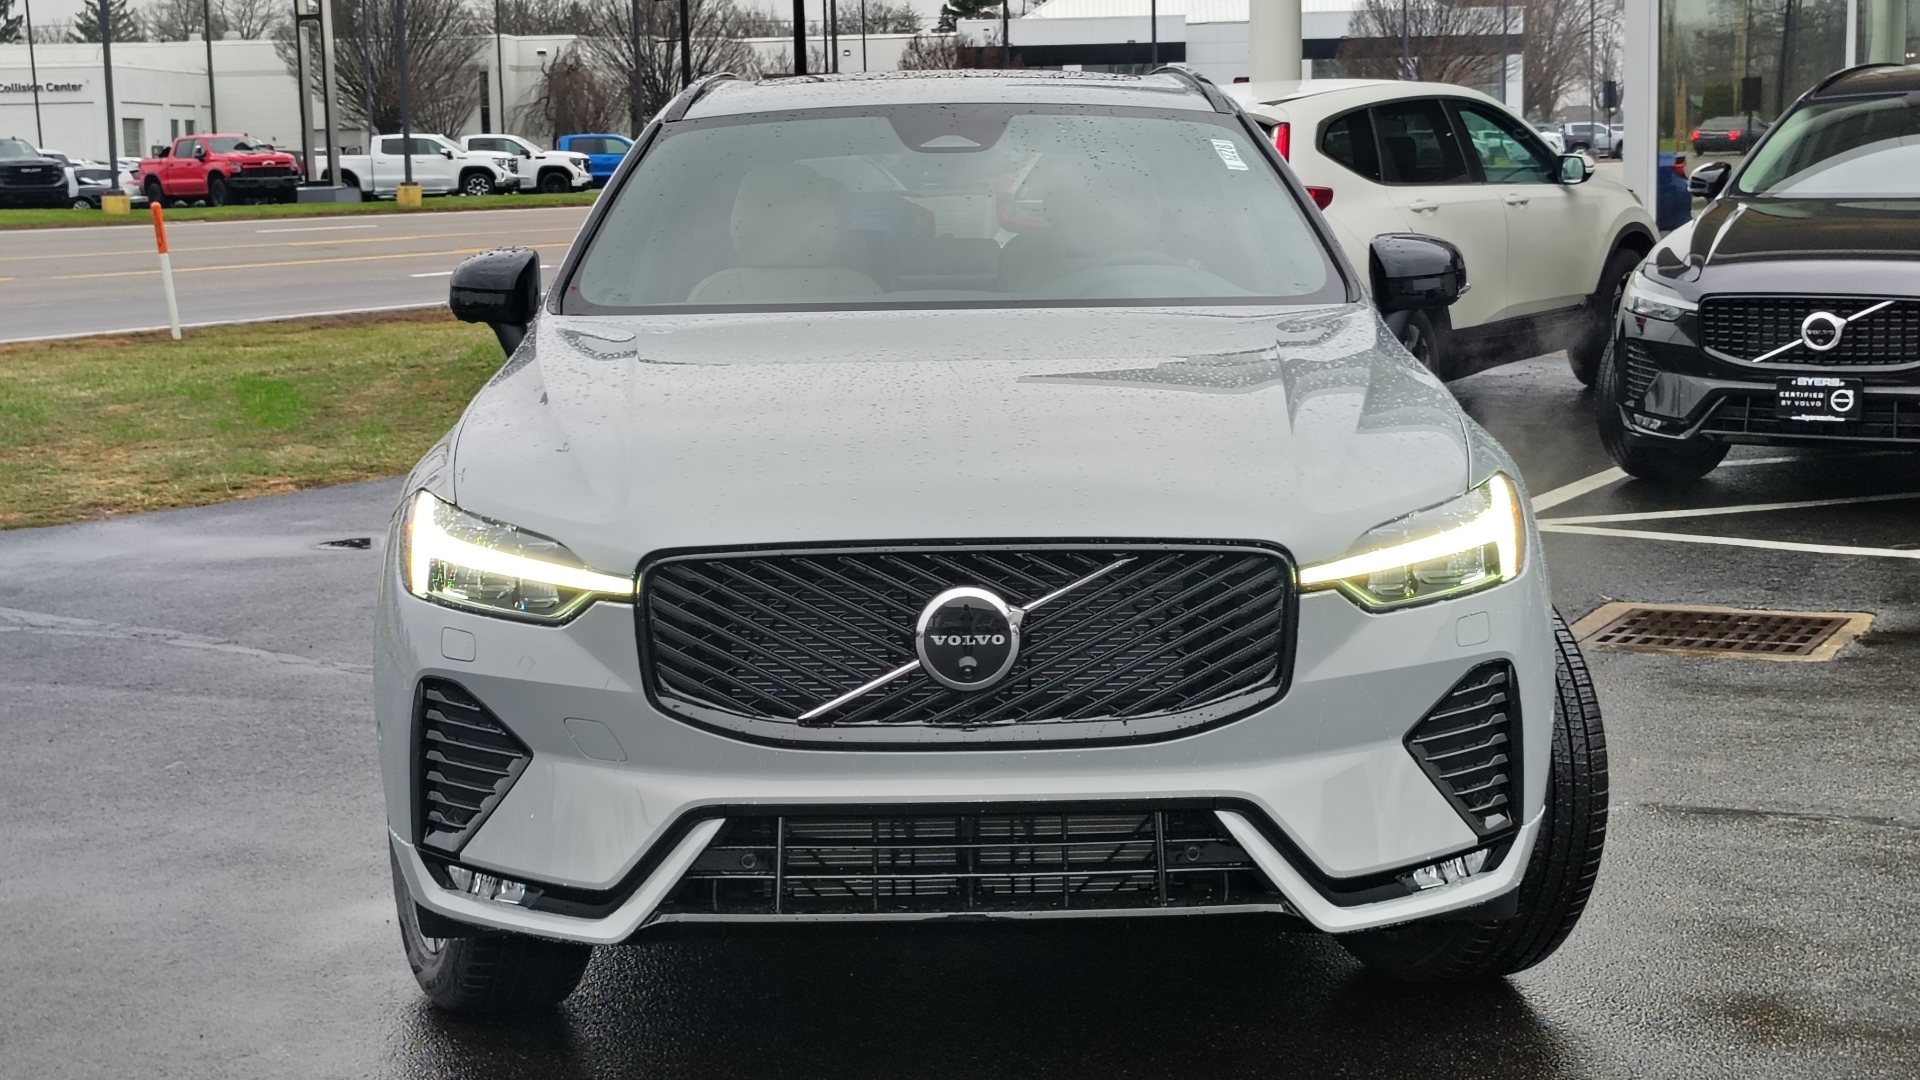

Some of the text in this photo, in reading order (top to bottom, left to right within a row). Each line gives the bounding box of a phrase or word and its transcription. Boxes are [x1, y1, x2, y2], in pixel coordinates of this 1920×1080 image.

[46, 82, 83, 92] Center
[1779, 391, 1824, 399] CERTIFIED
[930, 634, 1005, 646] VOLVO
